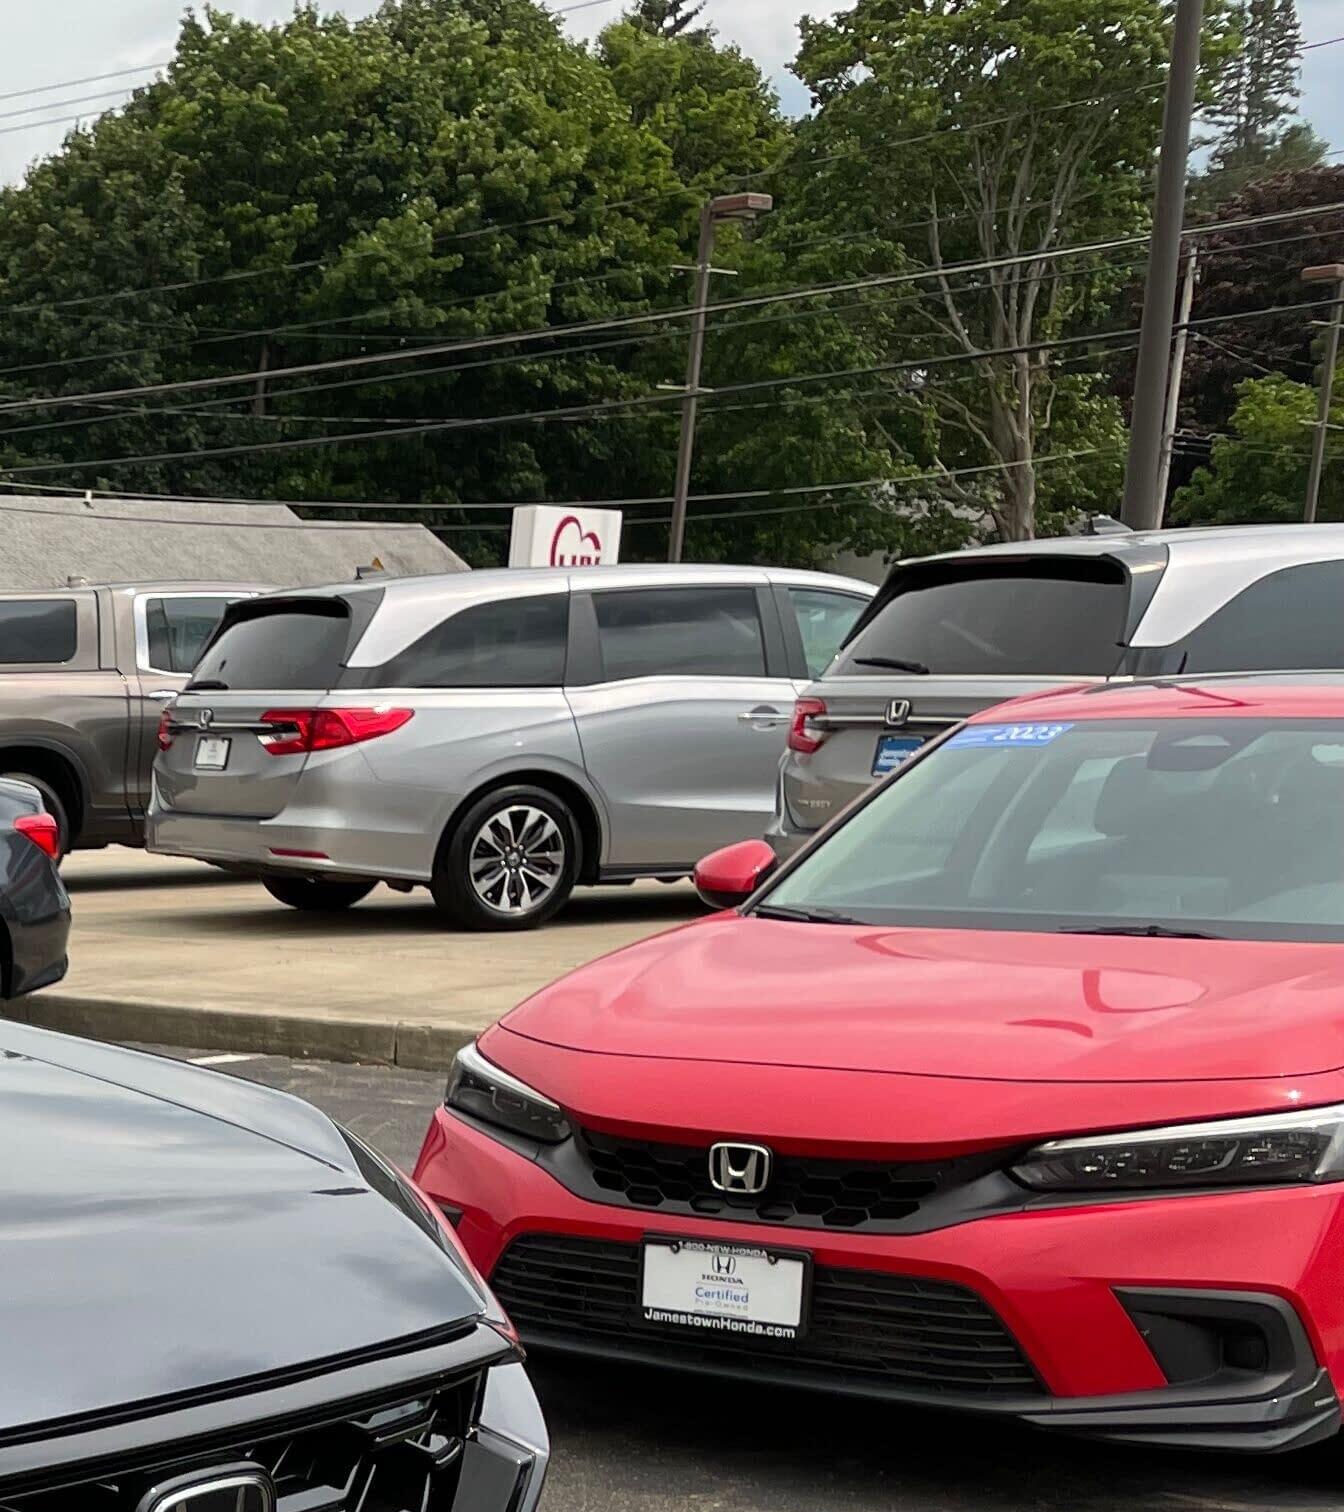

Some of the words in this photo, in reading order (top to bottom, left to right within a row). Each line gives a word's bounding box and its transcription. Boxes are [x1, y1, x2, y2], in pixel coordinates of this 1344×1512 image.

[701, 1273, 744, 1285] HONDA
[695, 1287, 749, 1303] Certified
[644, 1308, 796, 1338] JamestownHonda.com
